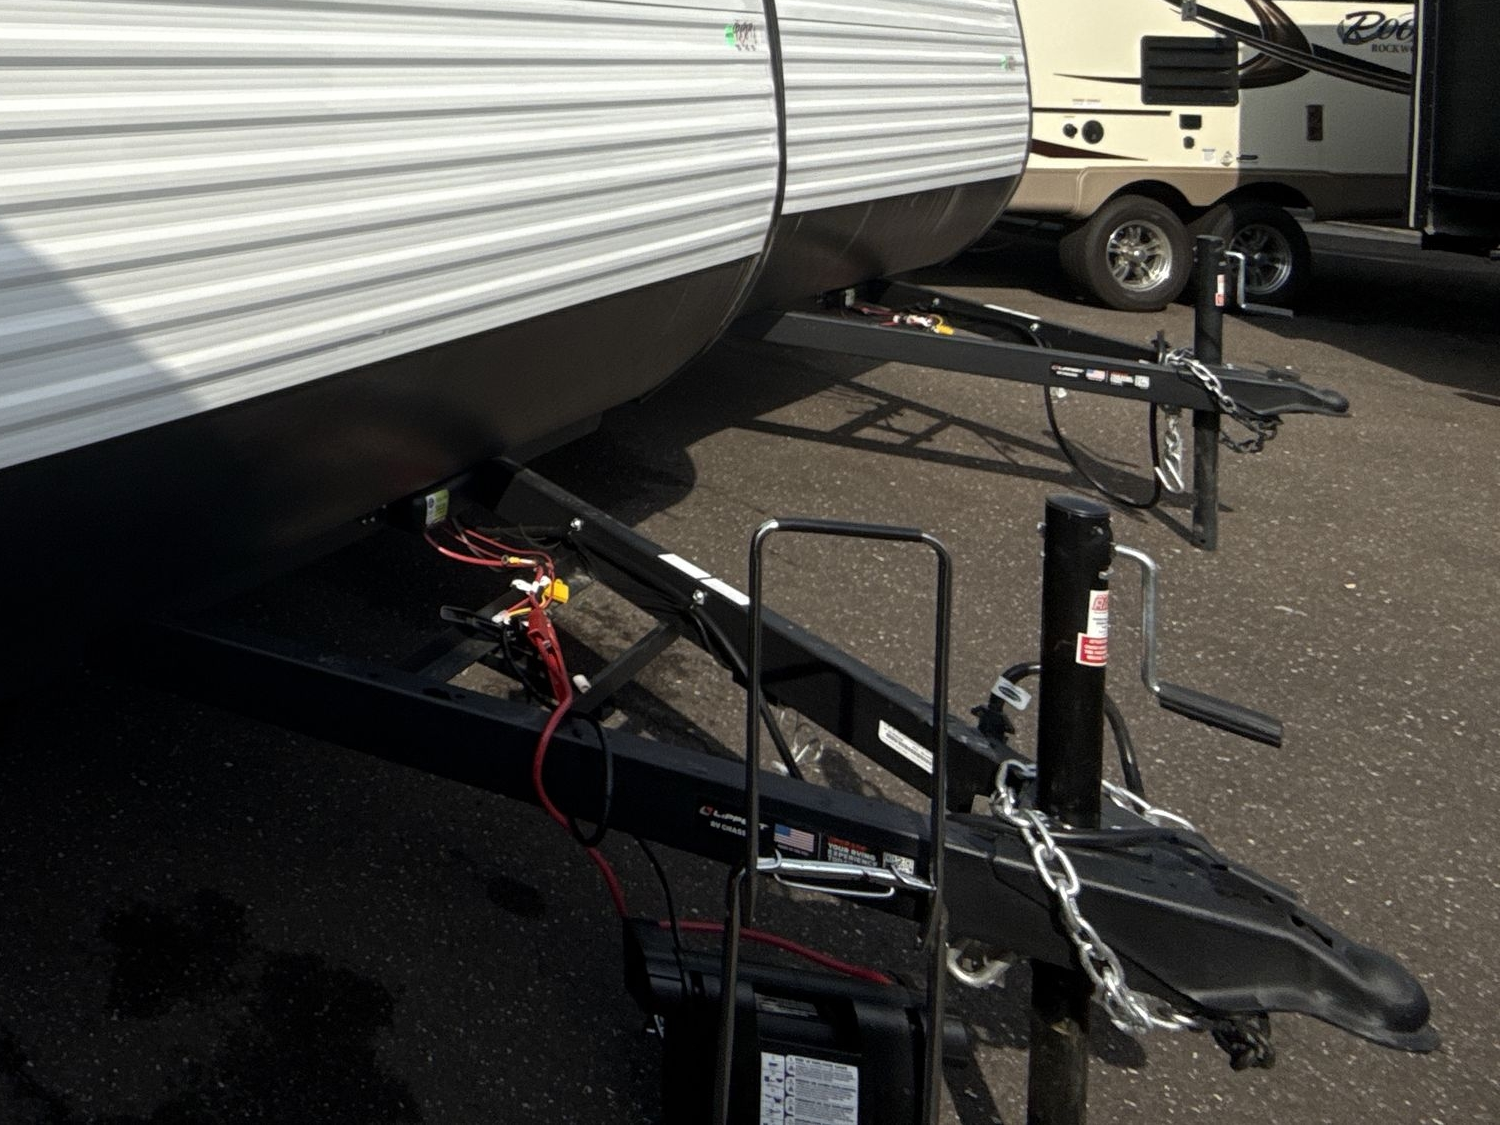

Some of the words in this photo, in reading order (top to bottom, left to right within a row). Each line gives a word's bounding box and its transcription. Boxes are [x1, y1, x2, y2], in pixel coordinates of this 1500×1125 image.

[1372, 43, 1414, 53] ROCKW
[721, 823, 747, 837] CHASS
[827, 842, 850, 853] YOUR
